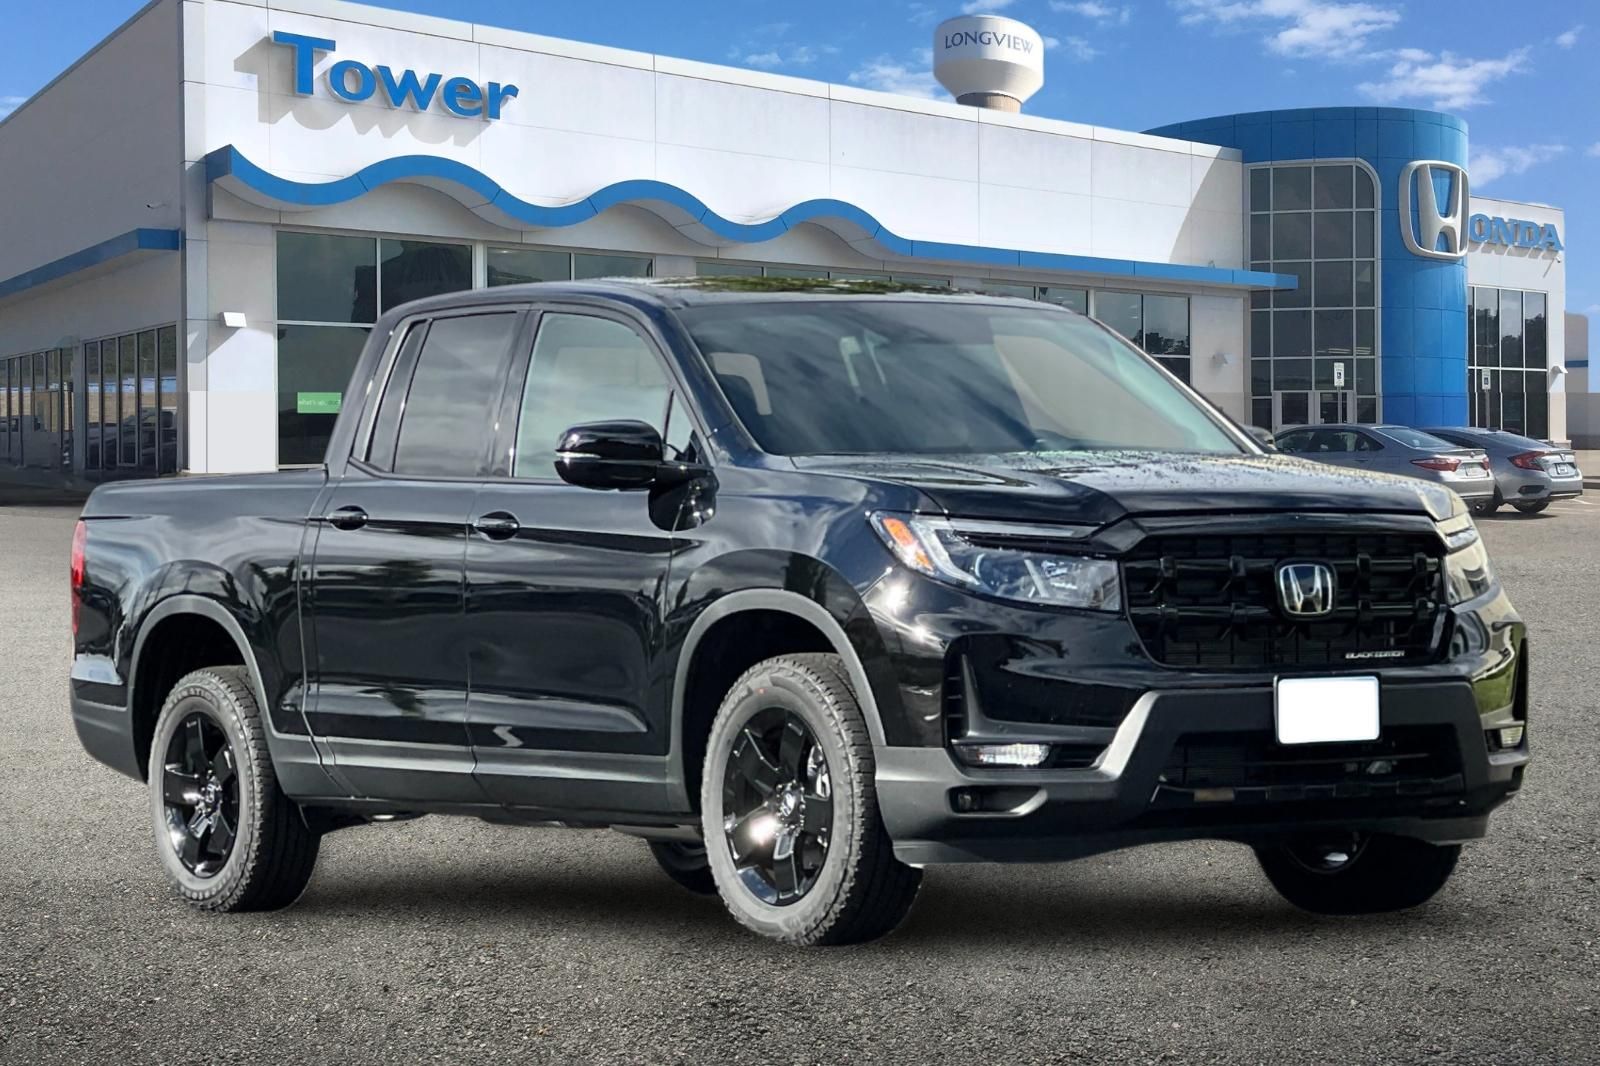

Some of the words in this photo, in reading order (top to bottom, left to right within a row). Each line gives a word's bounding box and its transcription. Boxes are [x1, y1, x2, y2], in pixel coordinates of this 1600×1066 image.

[945, 31, 1034, 55] LONGVIEW
[272, 30, 520, 121] Tower
[1469, 213, 1564, 251] ONDA
